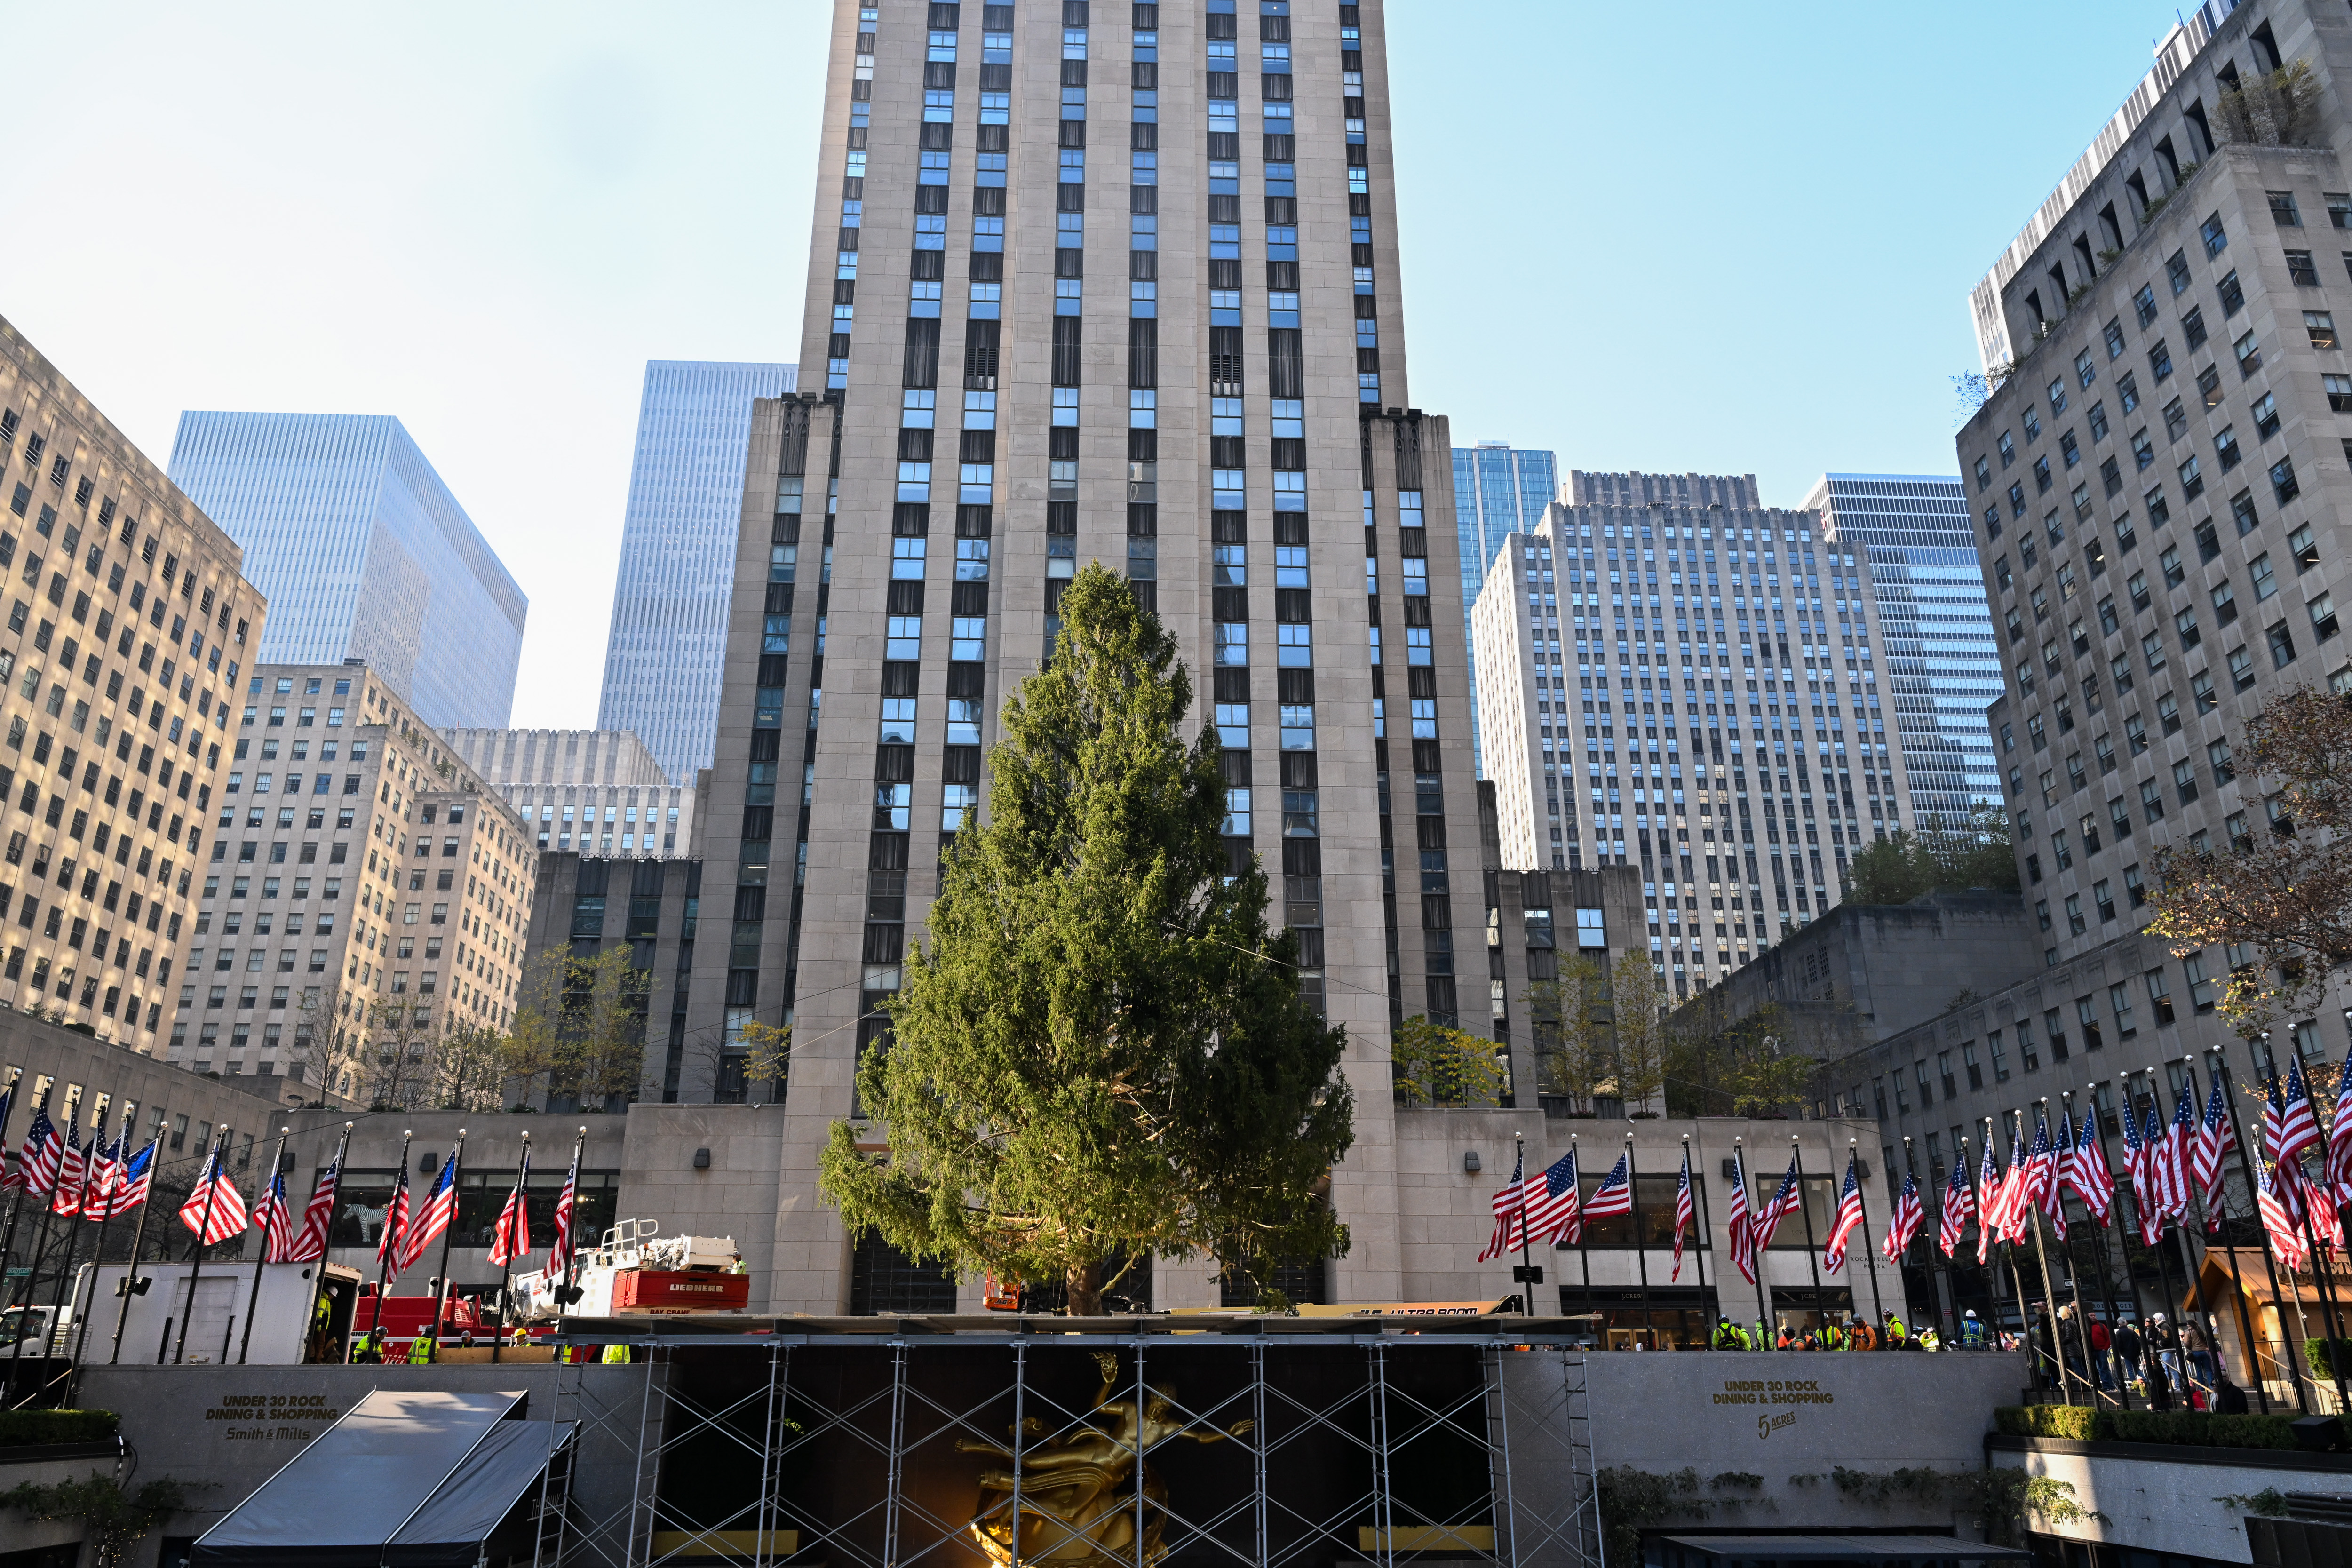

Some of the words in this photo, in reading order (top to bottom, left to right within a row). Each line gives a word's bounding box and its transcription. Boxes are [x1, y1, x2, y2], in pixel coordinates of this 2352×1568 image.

[670, 1284, 723, 1292] LIEBHERR
[1724, 1381, 1765, 1391] UNDER
[1767, 1381, 1783, 1391] 30
[1785, 1381, 1819, 1391] ROCK
[223, 1396, 266, 1407] UNDER
[269, 1396, 286, 1407] 30
[288, 1396, 326, 1407] ROCK
[1713, 1393, 1757, 1404] DINING
[1759, 1394, 1769, 1404] &
[1771, 1393, 1834, 1404] SHOPPING
[205, 1409, 254, 1420] DINING
[255, 1409, 266, 1420] &
[269, 1409, 338, 1420] SHOPPING
[1758, 1414, 1770, 1440] 5
[1771, 1411, 1796, 1428] ACRES
[226, 1427, 264, 1440] Smith
[266, 1429, 273, 1440] &
[276, 1427, 310, 1440] Mills
